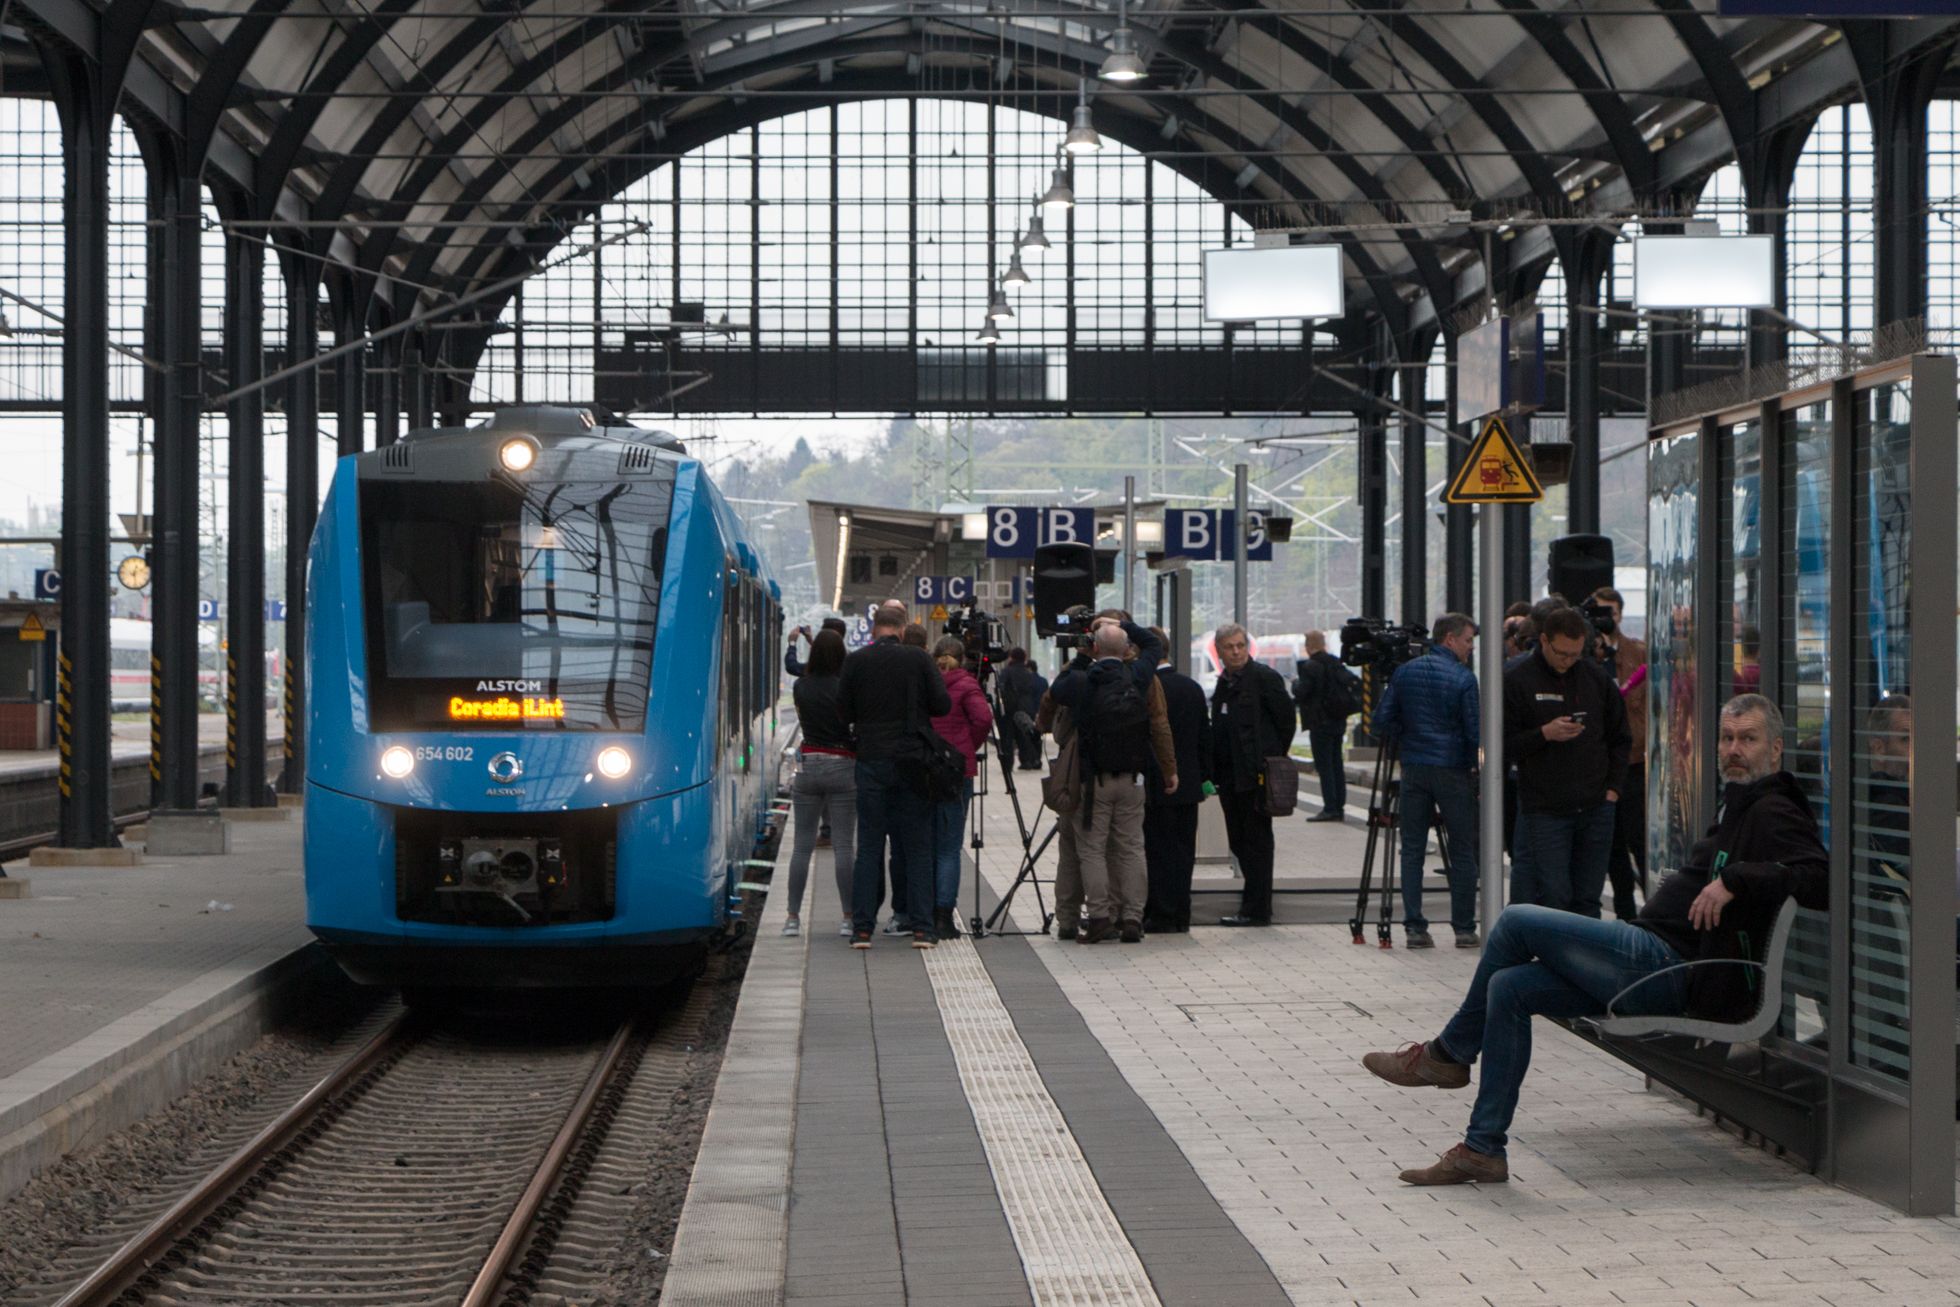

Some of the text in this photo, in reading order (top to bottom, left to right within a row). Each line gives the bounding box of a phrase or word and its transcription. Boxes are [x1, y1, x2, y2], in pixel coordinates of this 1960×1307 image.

[993, 508, 1077, 547] 8 B
[1182, 511, 1210, 548] B
[43, 570, 61, 593] C
[918, 577, 966, 599] 8 C
[199, 600, 213, 617] D
[476, 680, 541, 692] ALSTOM
[450, 697, 565, 717] Coradia iLint
[416, 746, 473, 761] 654 602
